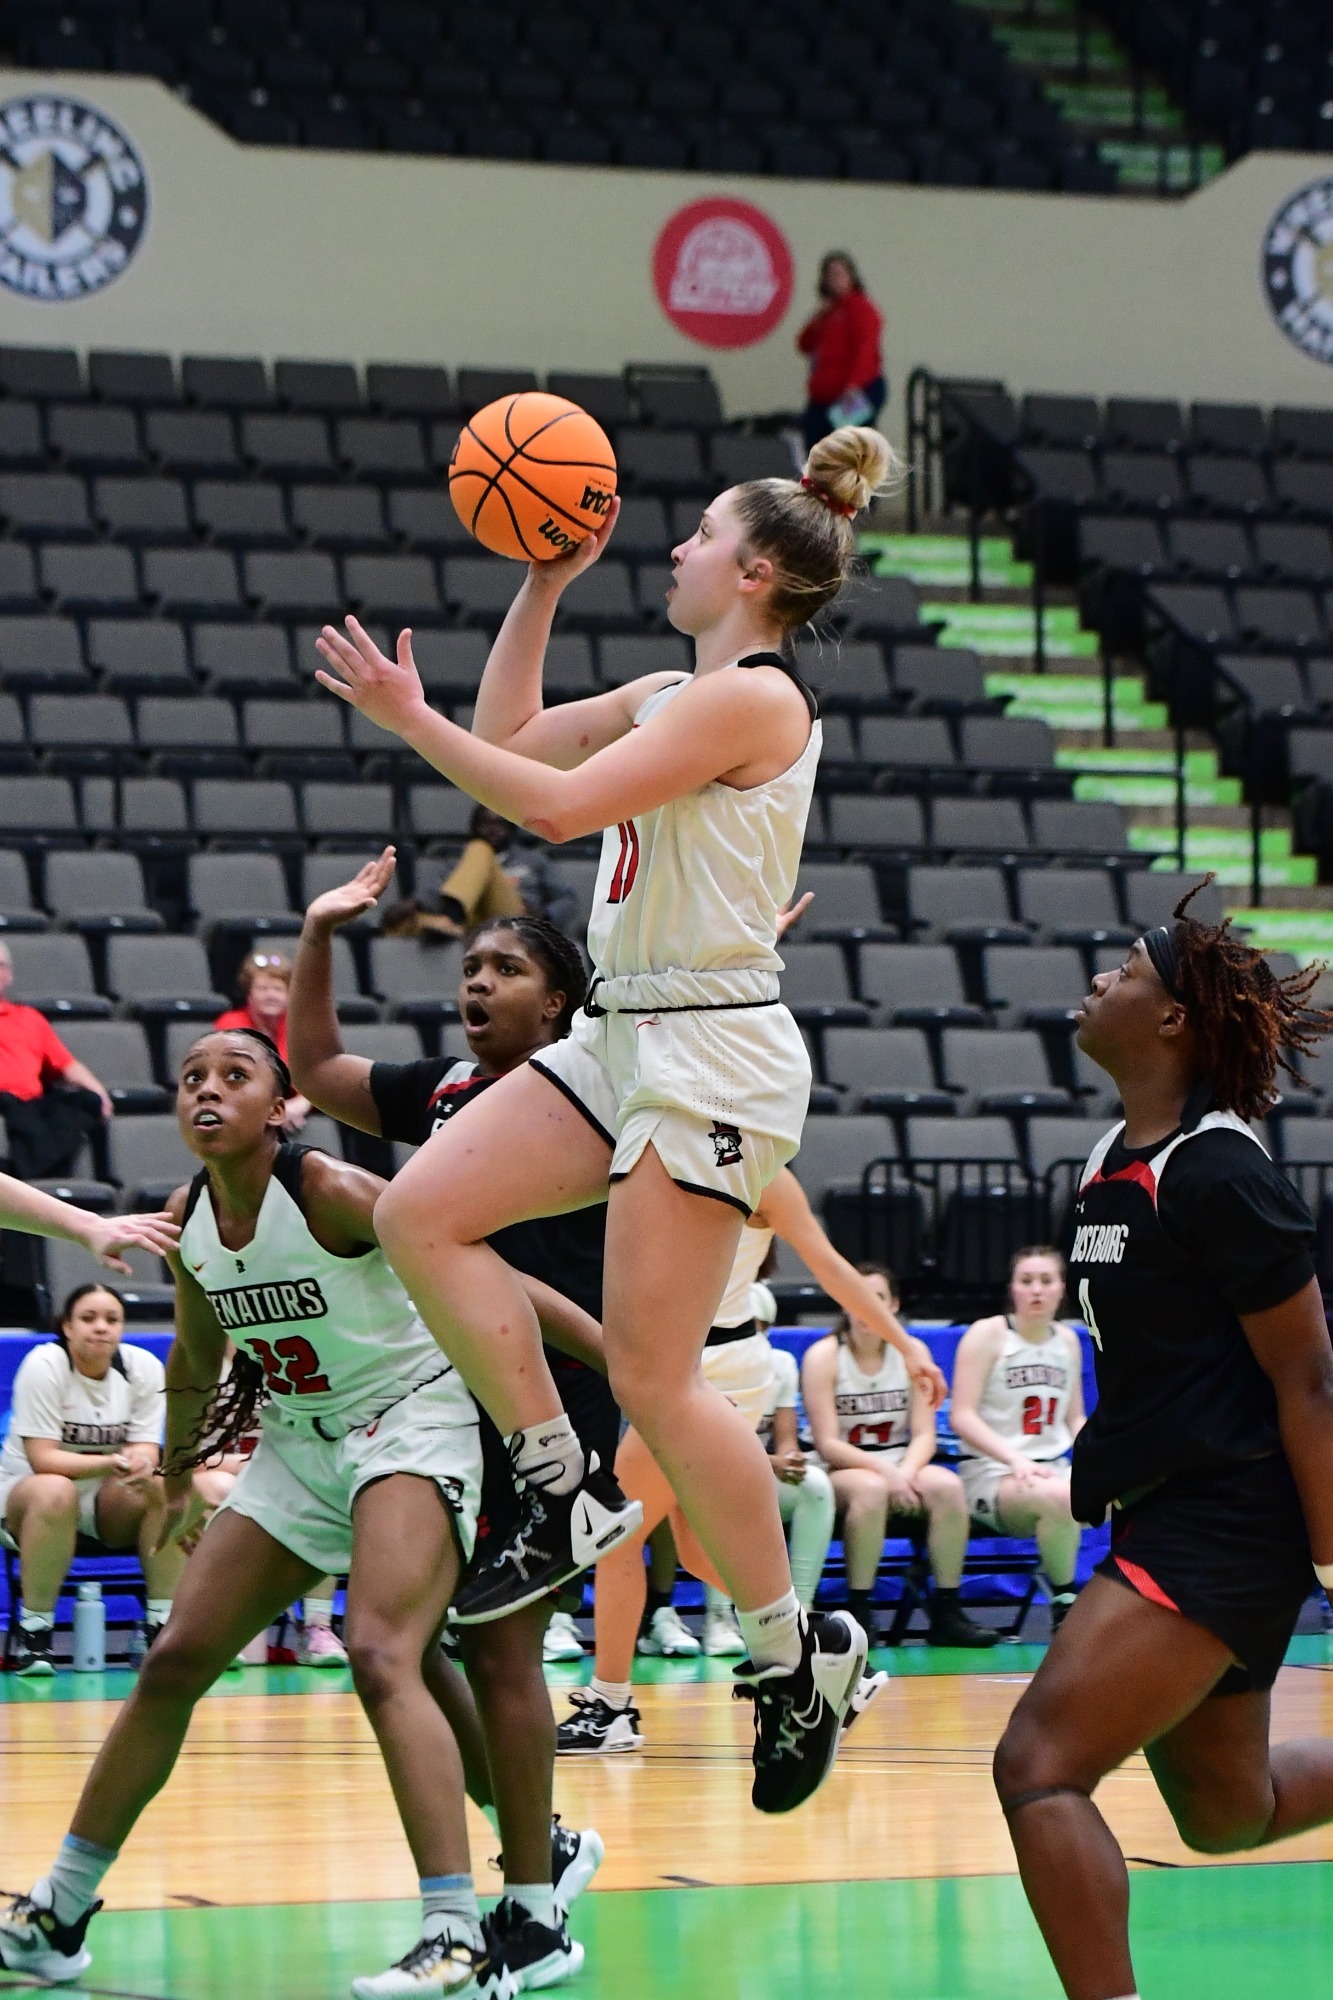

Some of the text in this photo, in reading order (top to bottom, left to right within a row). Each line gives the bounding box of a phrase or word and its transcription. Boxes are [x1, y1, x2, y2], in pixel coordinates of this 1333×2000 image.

[0, 242, 126, 297] AILERS
[580, 485, 613, 516] CAA
[538, 518, 582, 553] son
[206, 1280, 327, 1328] ENATORS
[1023, 1396, 1058, 1435] 21
